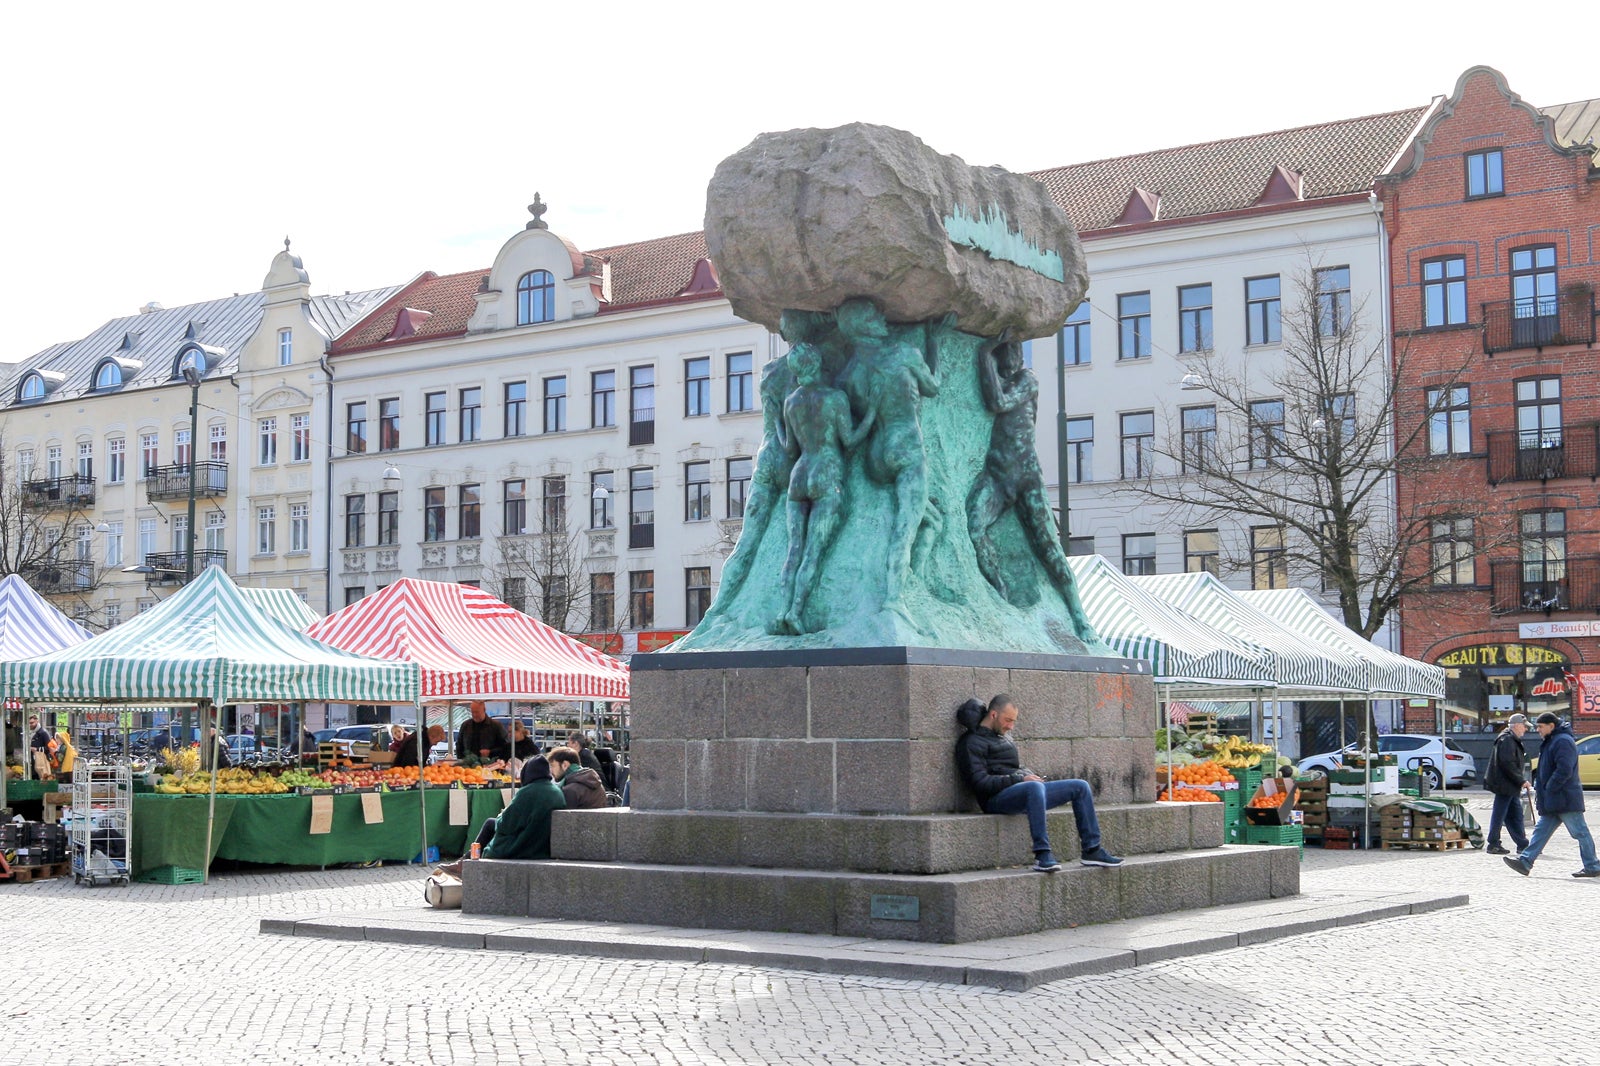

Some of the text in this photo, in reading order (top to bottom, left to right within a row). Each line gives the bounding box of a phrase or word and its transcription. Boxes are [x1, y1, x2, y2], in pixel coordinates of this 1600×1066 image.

[1550, 623, 1589, 636] Beauty
[1441, 646, 1562, 665] BEAUTY CENTER
